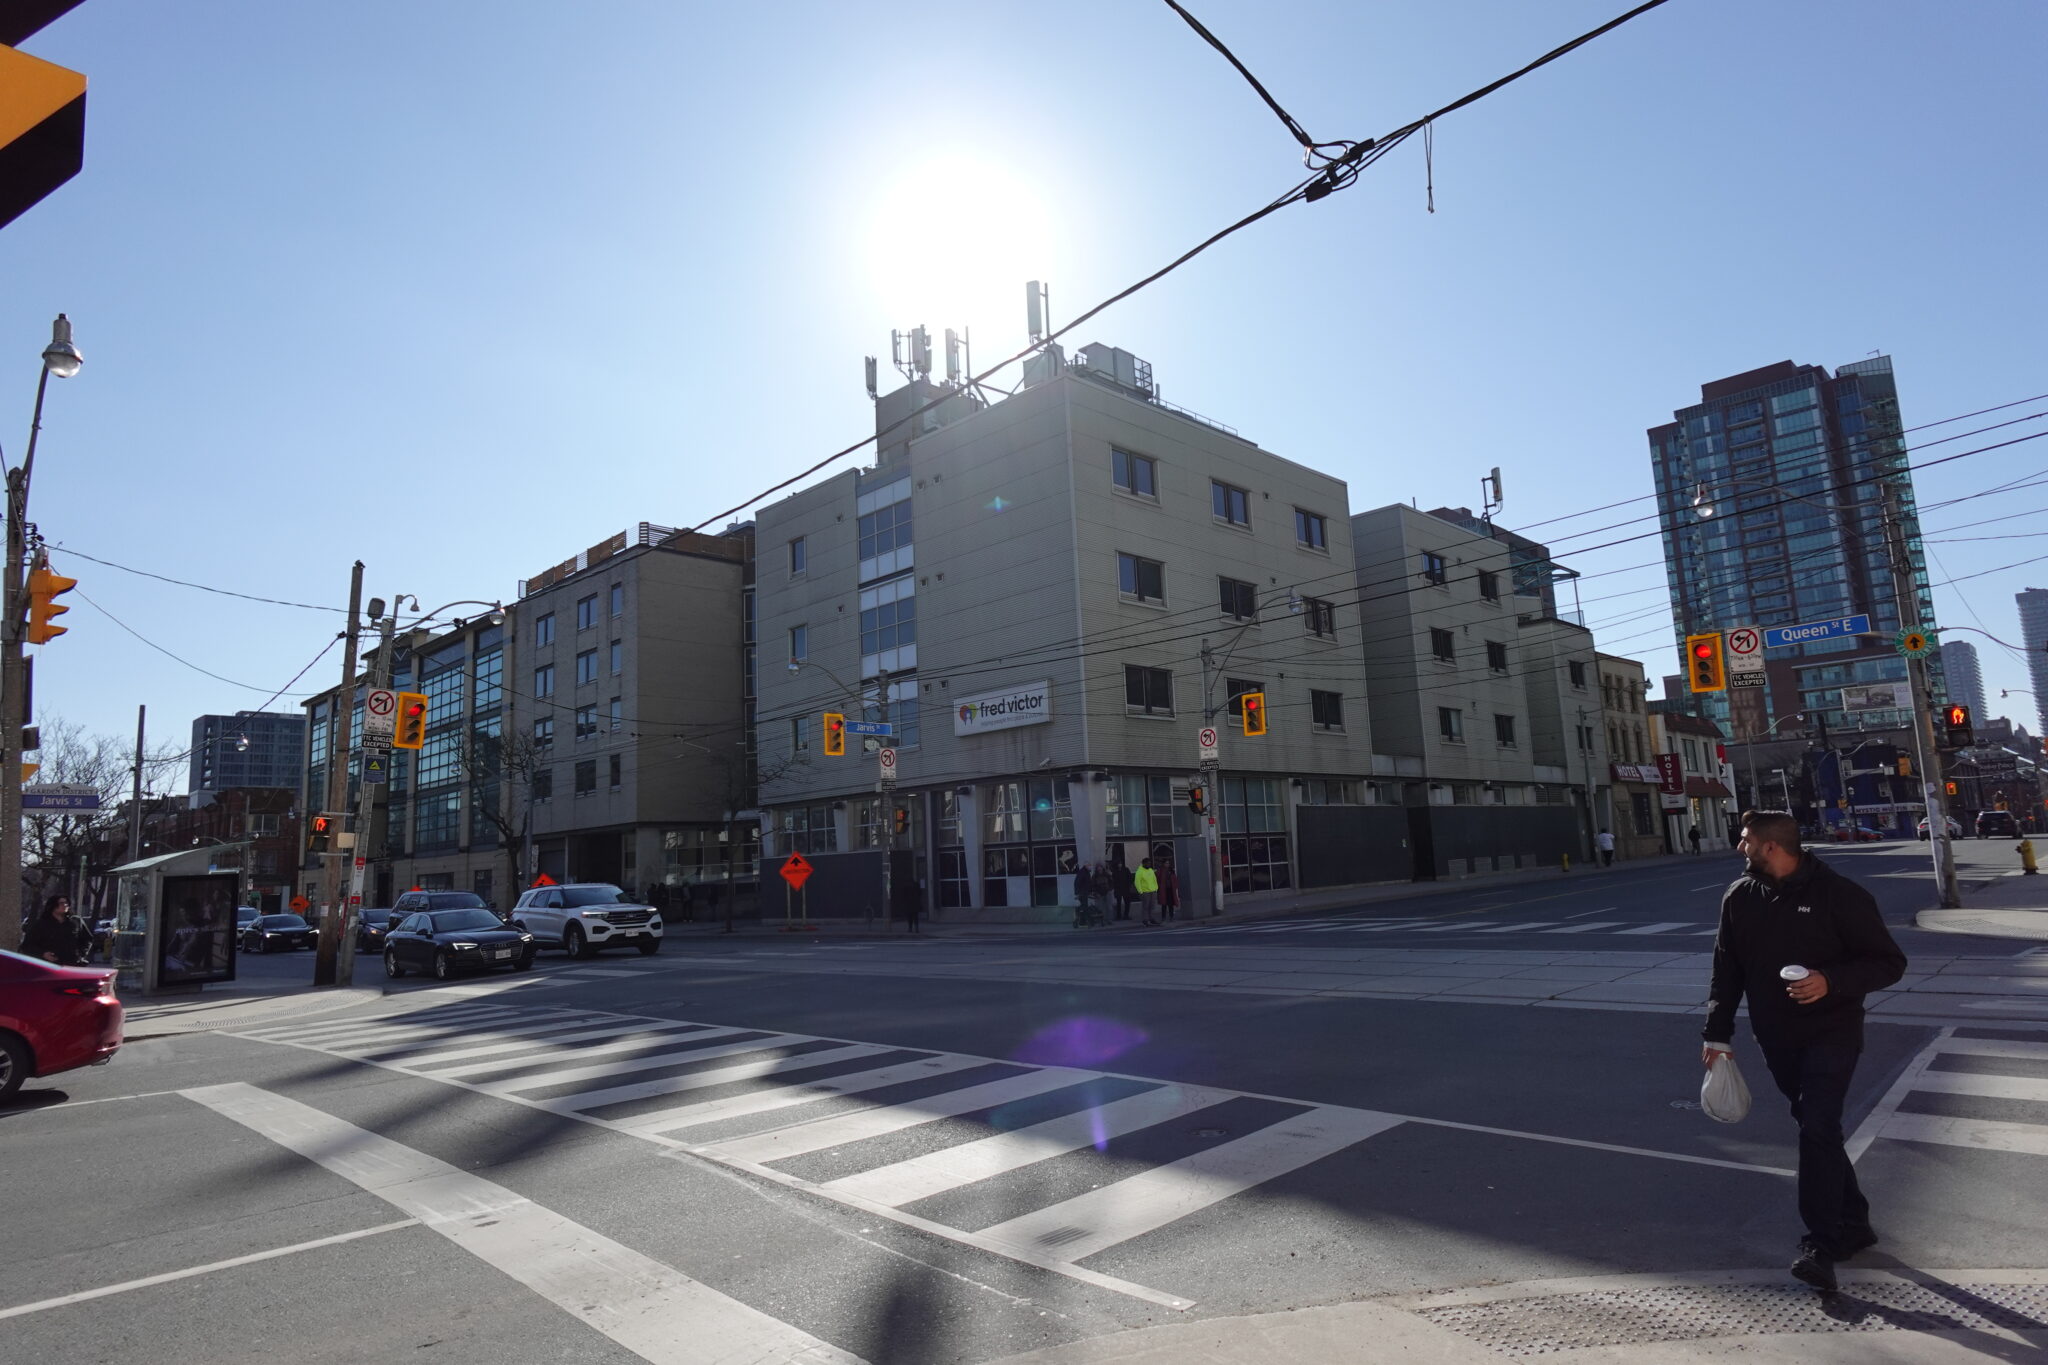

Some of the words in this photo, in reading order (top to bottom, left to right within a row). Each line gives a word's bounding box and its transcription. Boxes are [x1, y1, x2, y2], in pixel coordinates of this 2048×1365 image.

[1781, 624, 1829, 642] Queen
[1831, 621, 1840, 629] St
[1842, 619, 1853, 632] E
[1743, 672, 1765, 680] VEHICLES
[1733, 679, 1764, 687] EXCEPTED
[980, 697, 1006, 718] fred
[1007, 694, 1043, 713] victor
[857, 723, 876, 732] Jarvis
[1616, 765, 1641, 777] HOTEL
[1664, 755, 1675, 790] HOTEL
[41, 796, 70, 806] Jarvis
[1797, 905, 1811, 913] HH
